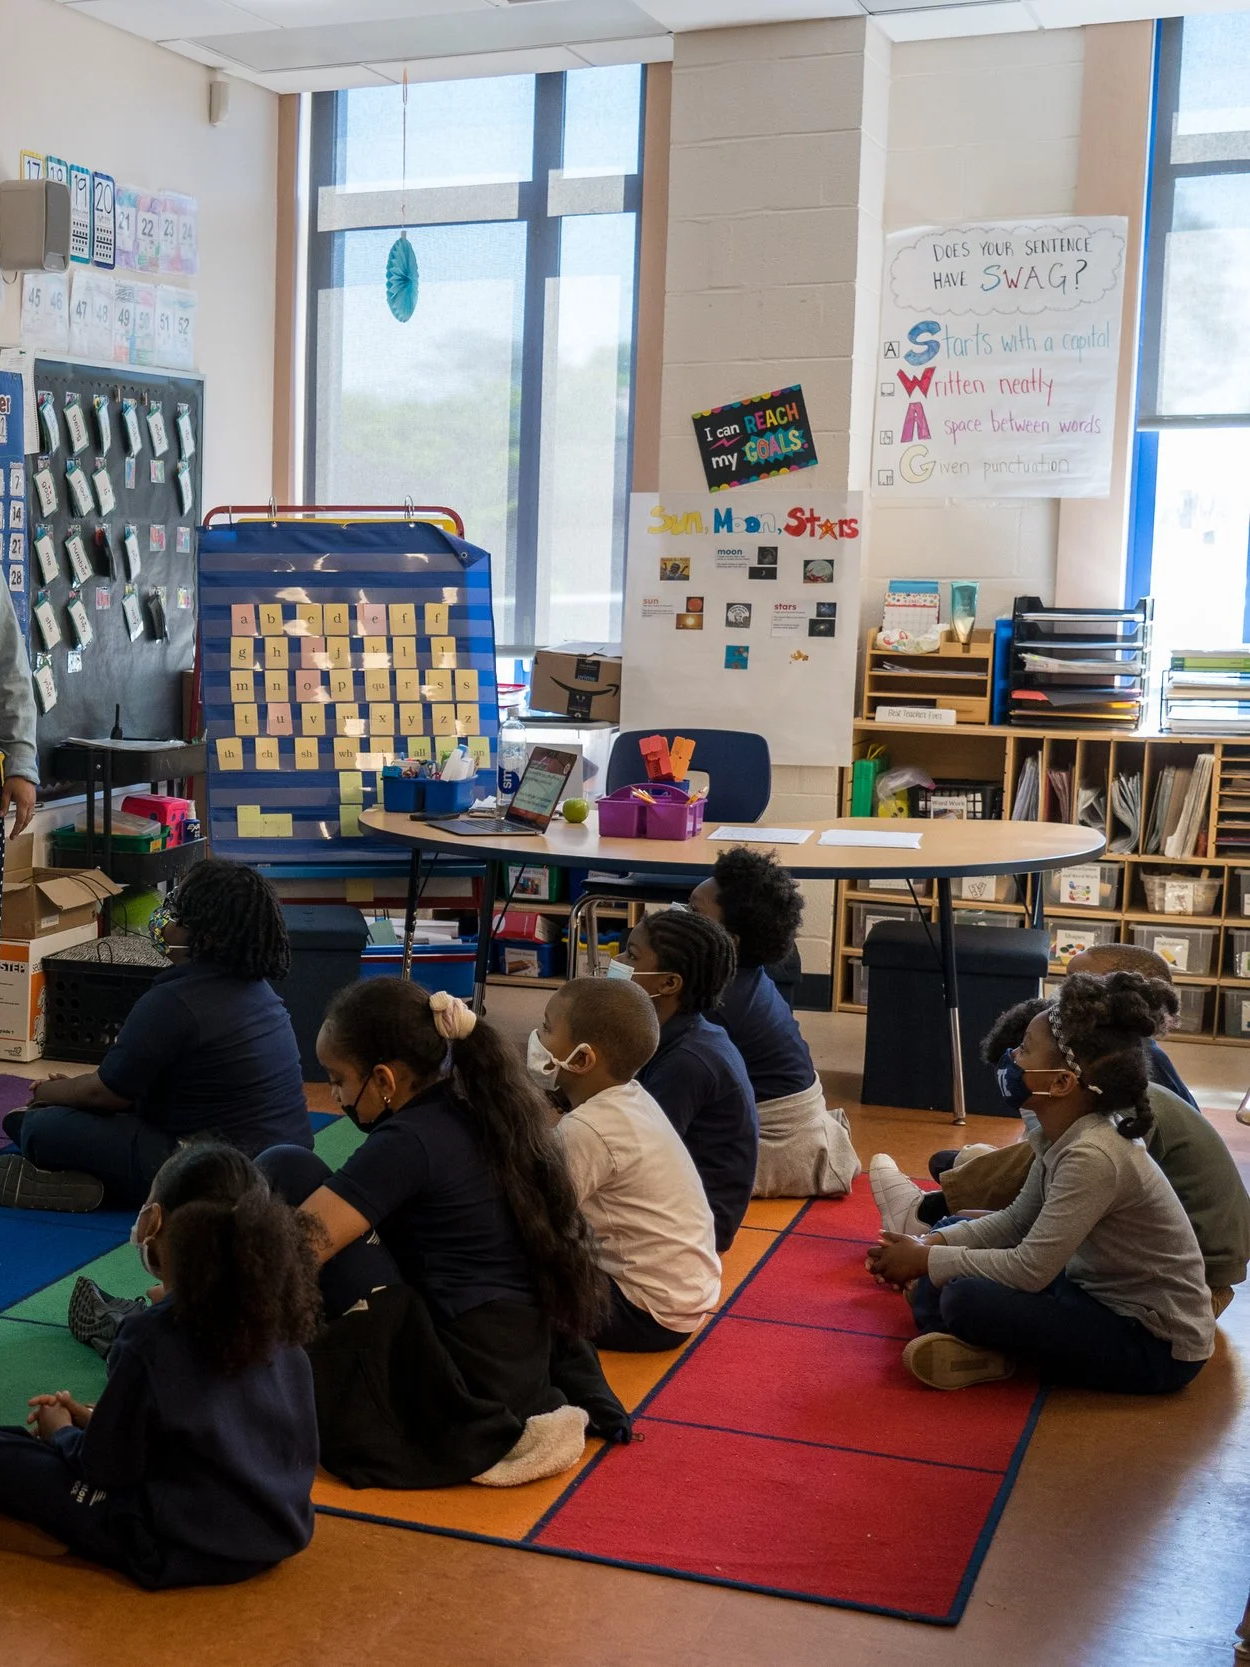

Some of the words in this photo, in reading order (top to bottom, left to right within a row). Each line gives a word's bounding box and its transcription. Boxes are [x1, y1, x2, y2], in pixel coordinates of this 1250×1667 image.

[74, 174, 87, 208] 19
[96, 182, 113, 214] 20
[141, 219, 153, 237] 22
[933, 241, 970, 262] DOES
[979, 241, 1014, 257] YOUR
[1025, 237, 1093, 256] SENTENCE
[933, 271, 968, 290] HAVE
[981, 259, 1088, 295] SWAG?
[178, 317, 190, 335] 52
[903, 320, 993, 366] Starts
[1001, 325, 1036, 353] with
[1044, 337, 1054, 352] a
[1062, 322, 1110, 363] capital
[896, 366, 986, 399] Written
[999, 367, 1053, 407] neatly
[72, 414, 81, 443] being
[704, 427, 713, 442] I
[716, 424, 740, 438] can
[744, 402, 800, 434] REACH
[900, 402, 932, 443] A
[944, 414, 982, 445] space
[990, 409, 1050, 434] between
[1059, 415, 1101, 434] words
[711, 452, 738, 471] my
[899, 444, 970, 484] Given
[983, 454, 1070, 481] punctuation
[42, 481, 52, 505] good
[13, 506, 21, 522] 14
[647, 505, 710, 535] Sun,
[713, 507, 783, 535] Moon,
[12, 539, 22, 554] 21
[72, 542, 88, 576] number
[717, 548, 742, 556] moon
[774, 603, 797, 611] stars
[224, 749, 234, 758] th
[261, 749, 273, 758] ch
[301, 749, 313, 758] sh
[338, 748, 353, 758] wh
[414, 748, 425, 757] all
